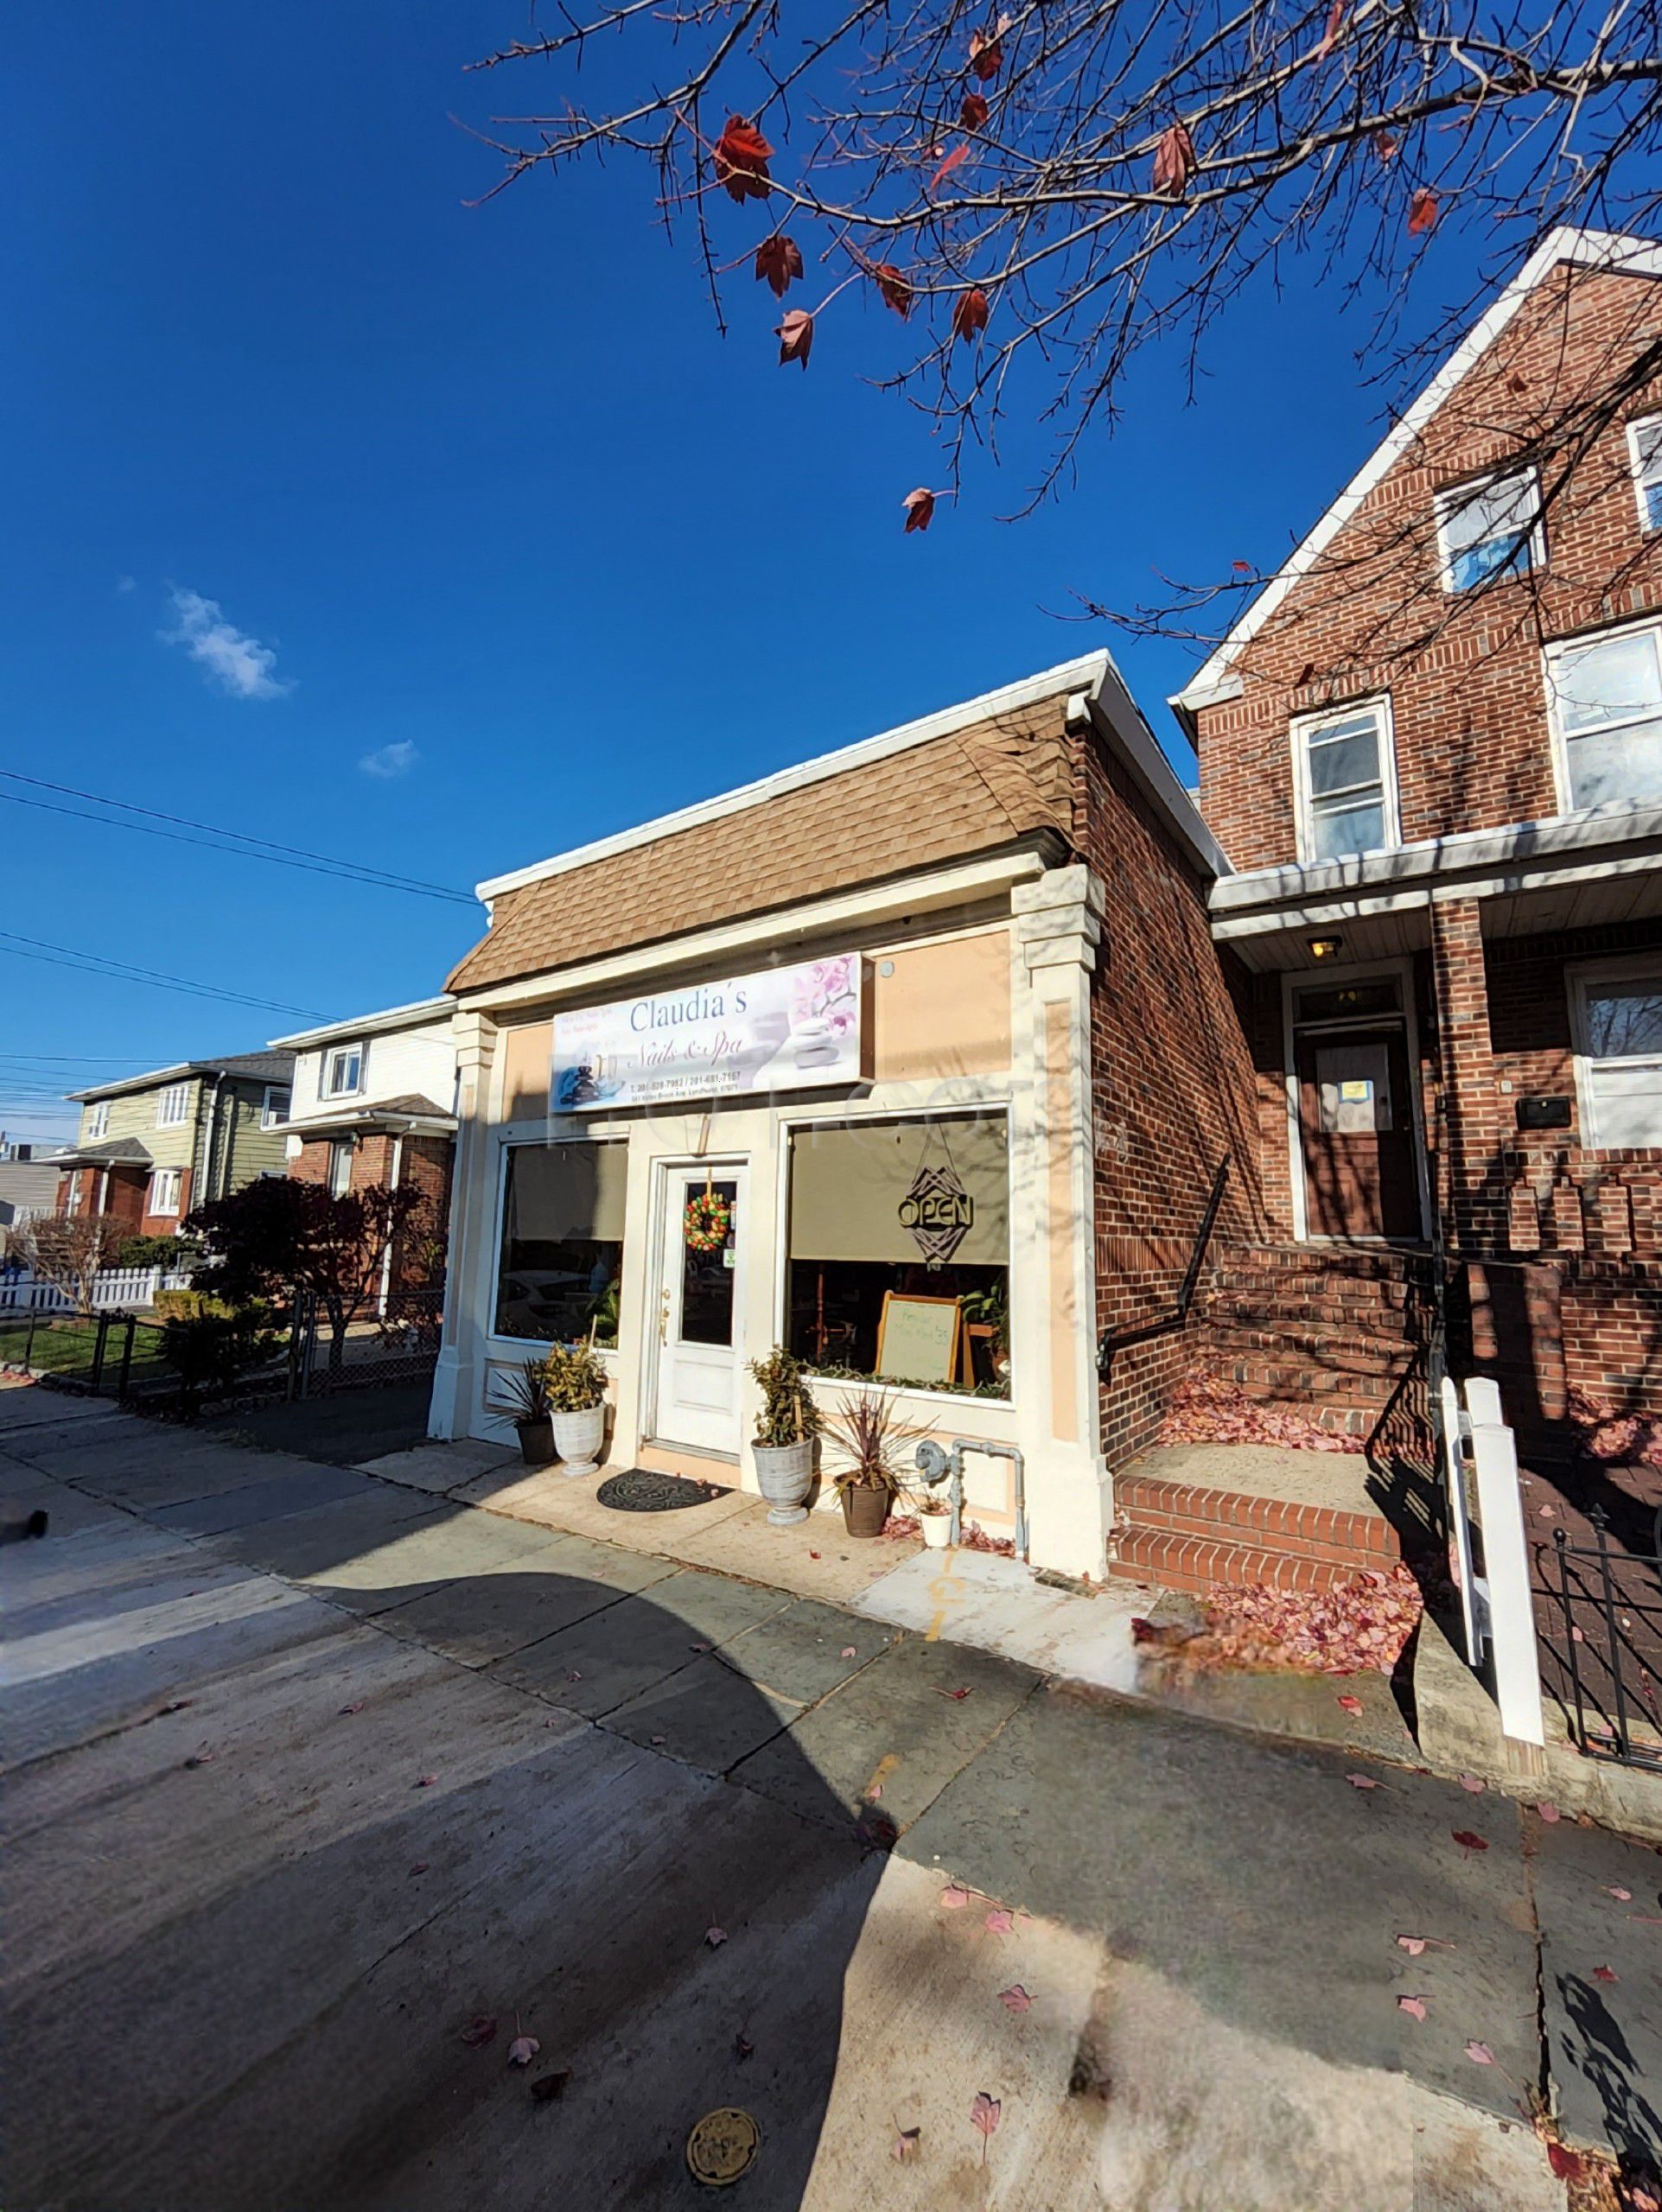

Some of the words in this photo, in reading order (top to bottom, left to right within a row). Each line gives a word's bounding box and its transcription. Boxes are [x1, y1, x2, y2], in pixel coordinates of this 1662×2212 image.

[630, 982, 748, 1033] Claudia's
[627, 1039, 678, 1070] Nails
[684, 1041, 701, 1060] &
[703, 1030, 743, 1066] Spa
[898, 1196, 973, 1228] OPEN
